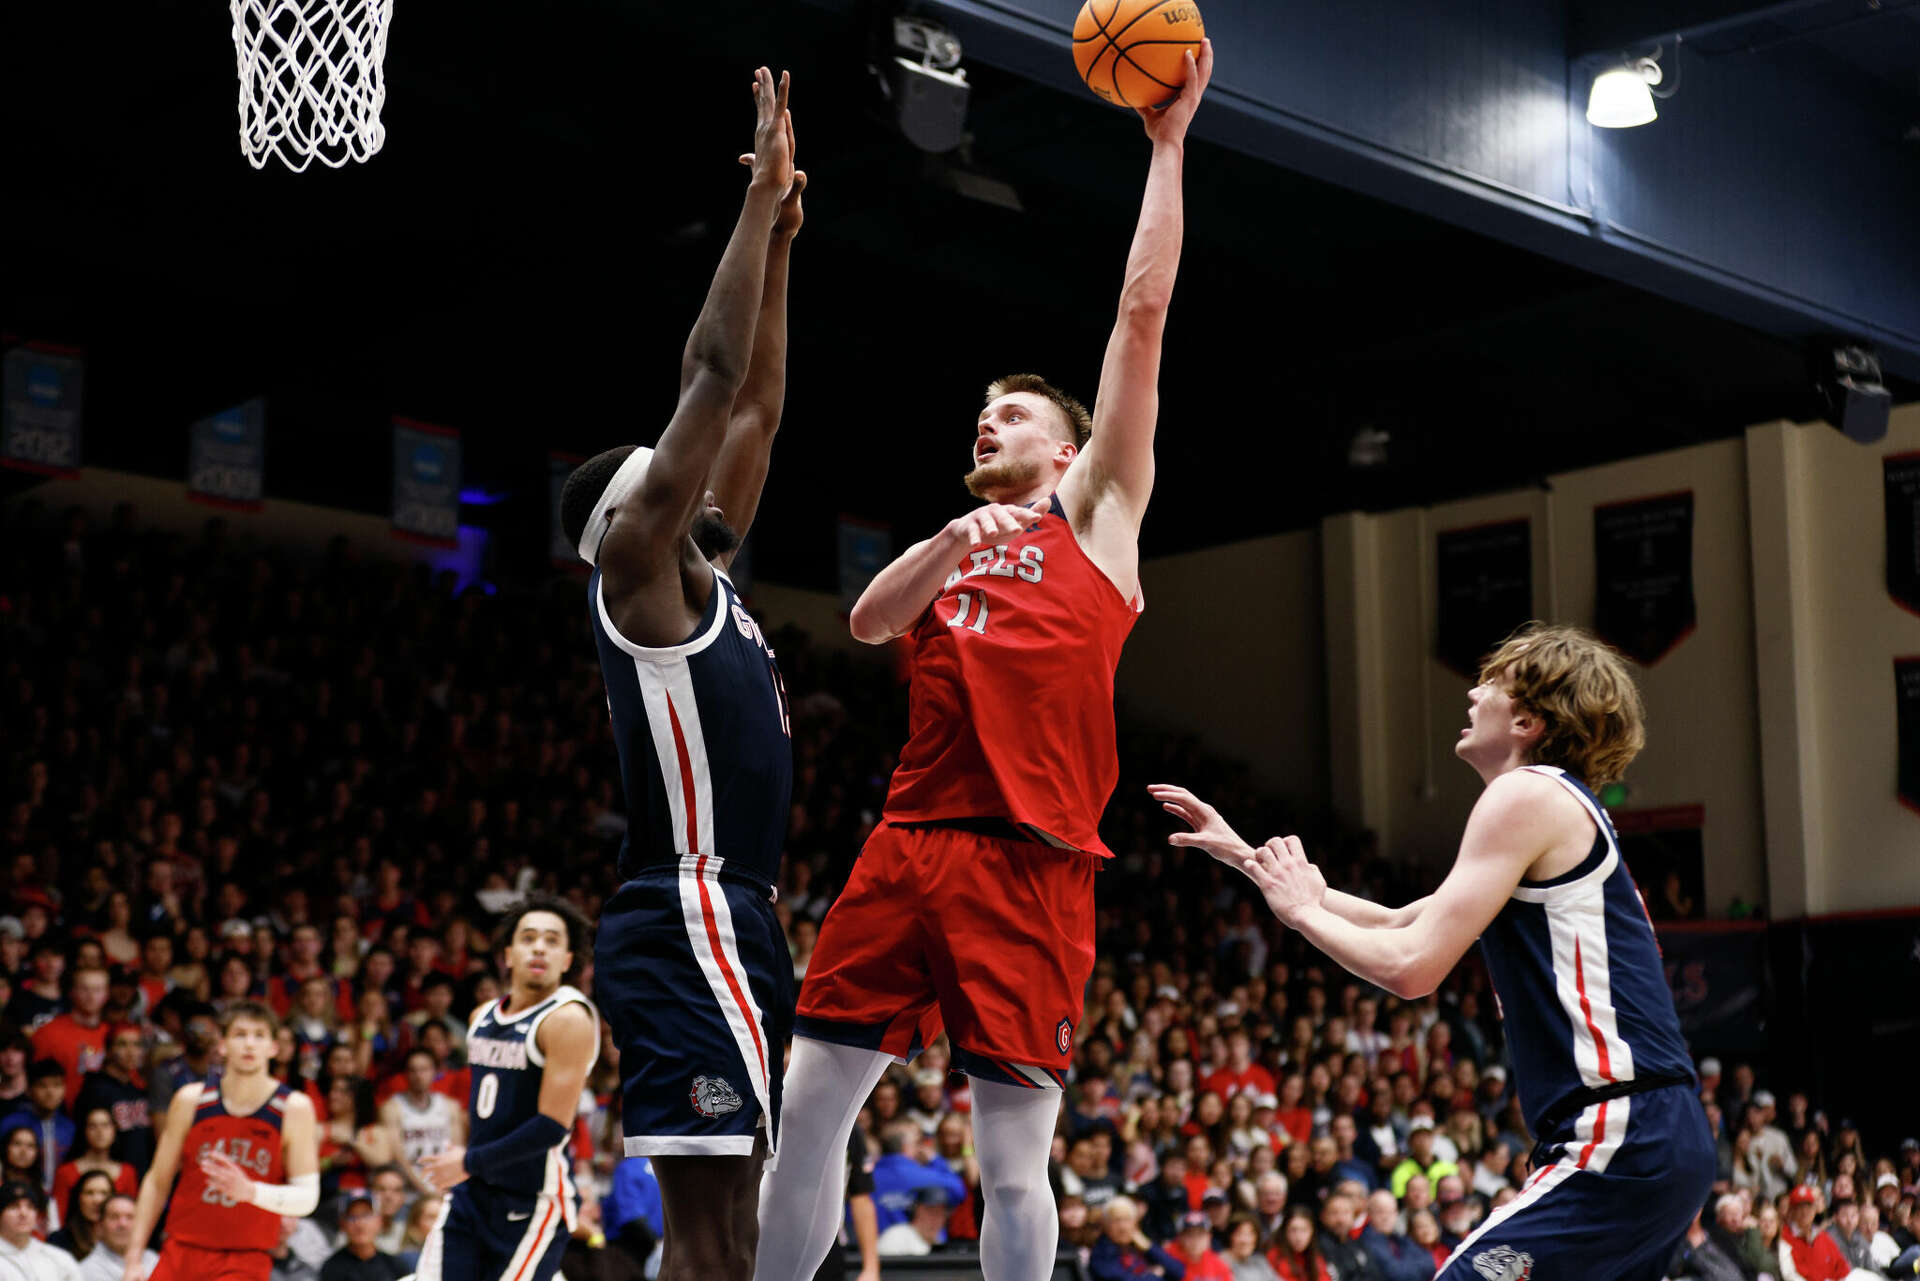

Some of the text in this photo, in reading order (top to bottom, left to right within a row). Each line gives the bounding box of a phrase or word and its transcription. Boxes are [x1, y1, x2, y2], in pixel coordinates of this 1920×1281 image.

[944, 545, 1045, 591] AELS
[947, 590, 988, 634] 11
[477, 1073, 498, 1119] 0
